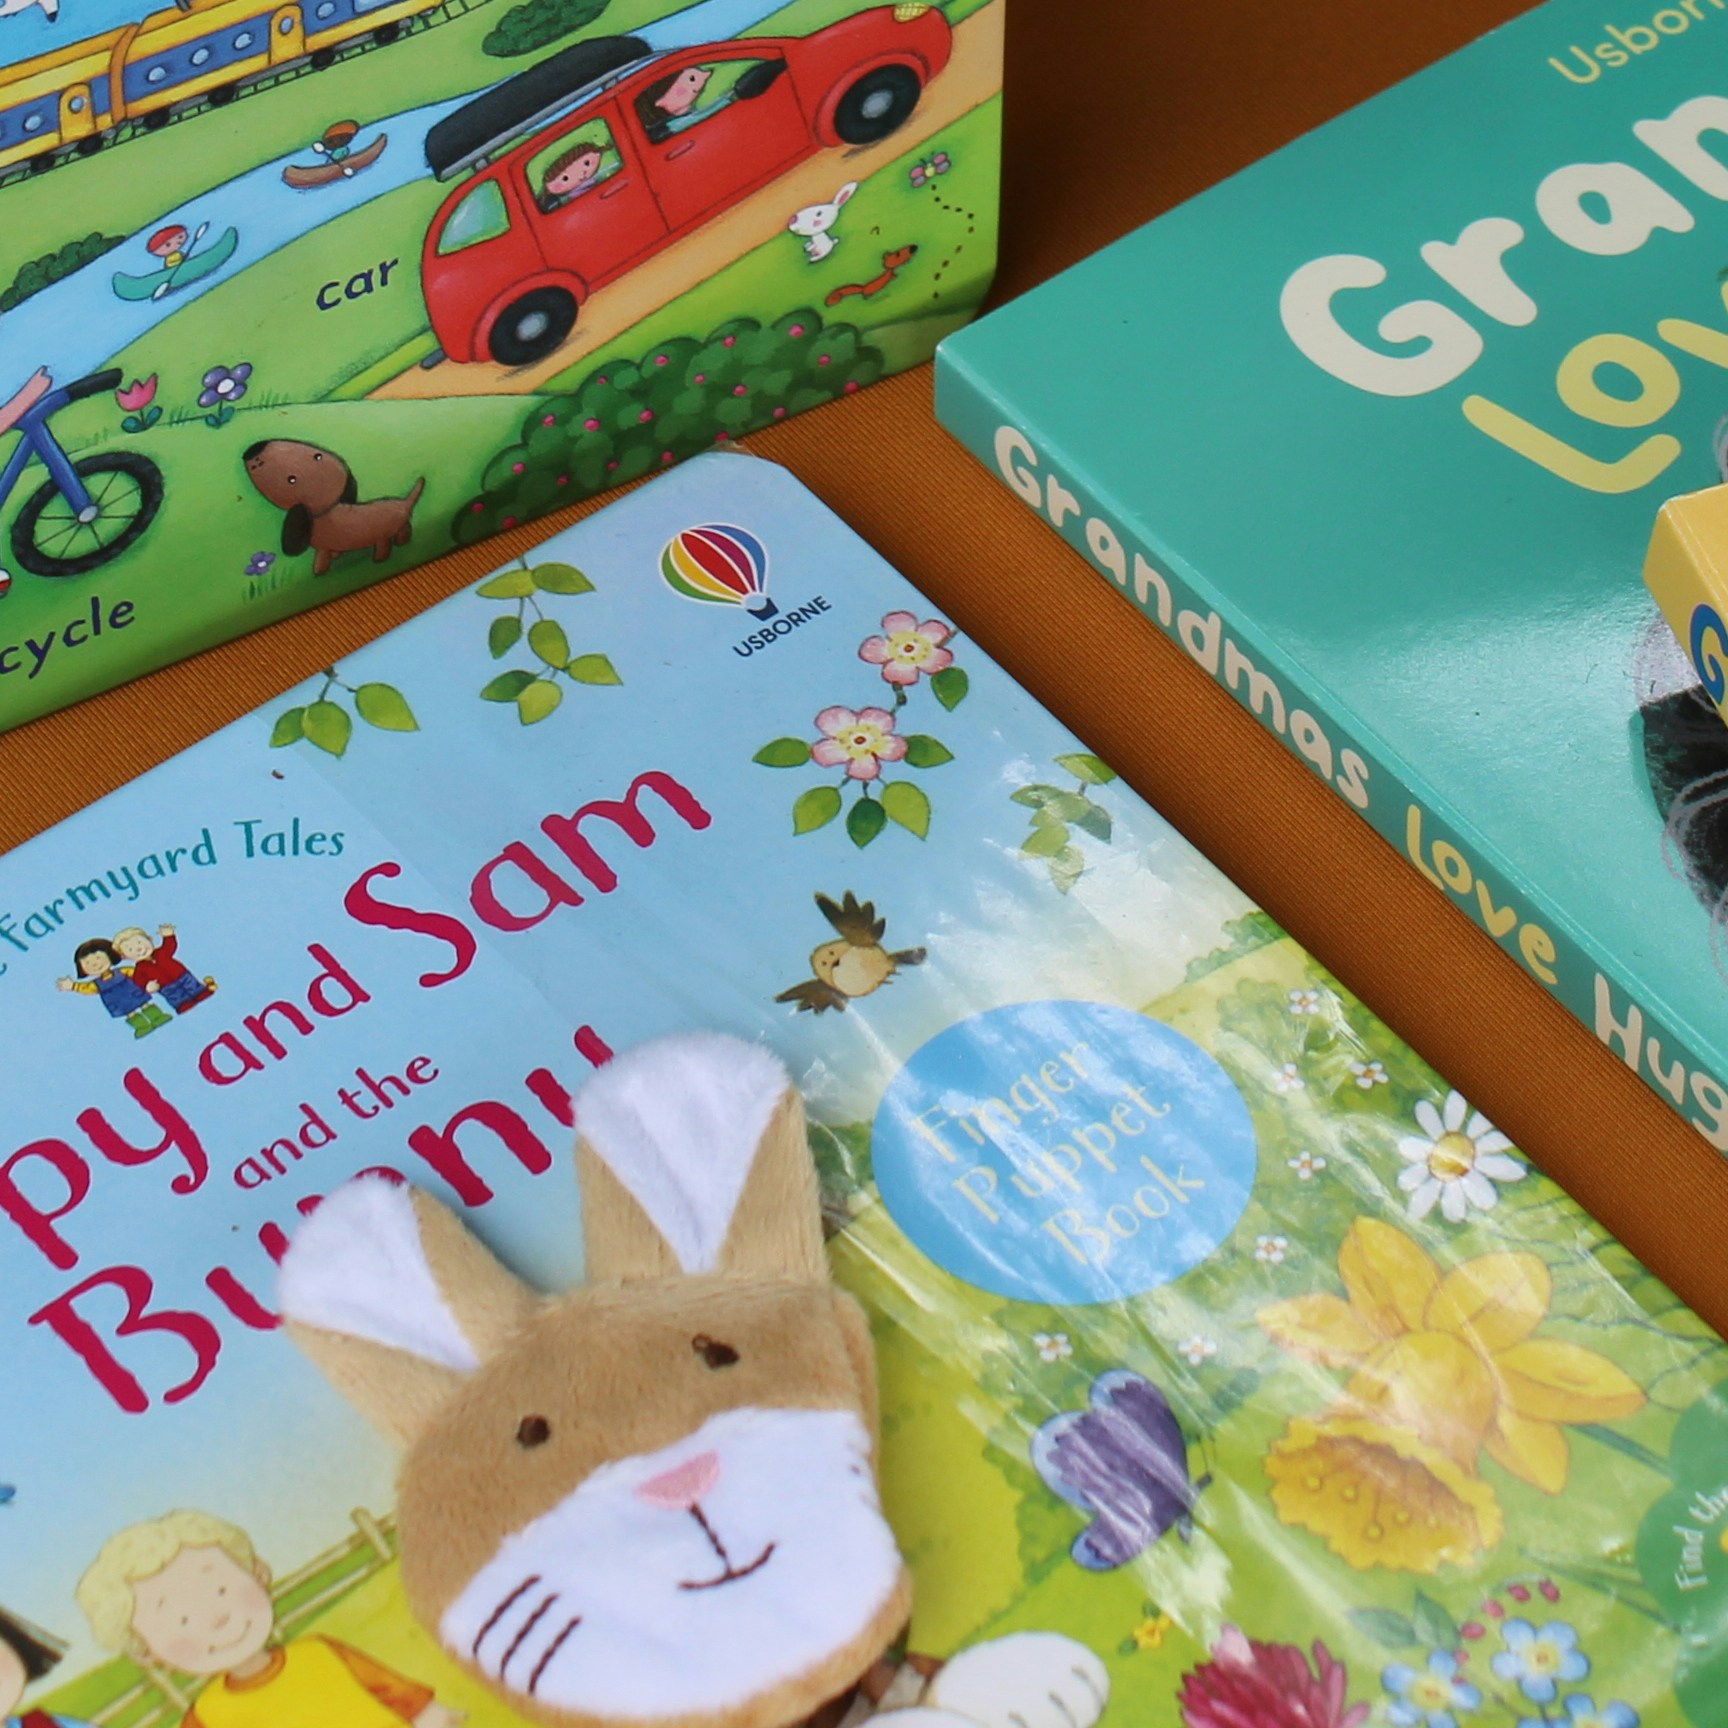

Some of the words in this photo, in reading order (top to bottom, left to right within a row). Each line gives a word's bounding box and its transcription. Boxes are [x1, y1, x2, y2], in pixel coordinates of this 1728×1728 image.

[315, 257, 400, 311] car
[732, 593, 834, 660] USBORNE
[993, 424, 1370, 809] Grandmas
[1405, 803, 1558, 986] Love
[232, 816, 346, 860] Tales
[197, 942, 373, 1087] and
[344, 769, 713, 989] Sam
[232, 1102, 339, 1190] and
[337, 1053, 441, 1120] the
[912, 1041, 1094, 1164] Finger
[952, 1082, 1171, 1224] Puppet
[1041, 1155, 1206, 1266] Book
[1673, 1525, 1709, 1591] Find
